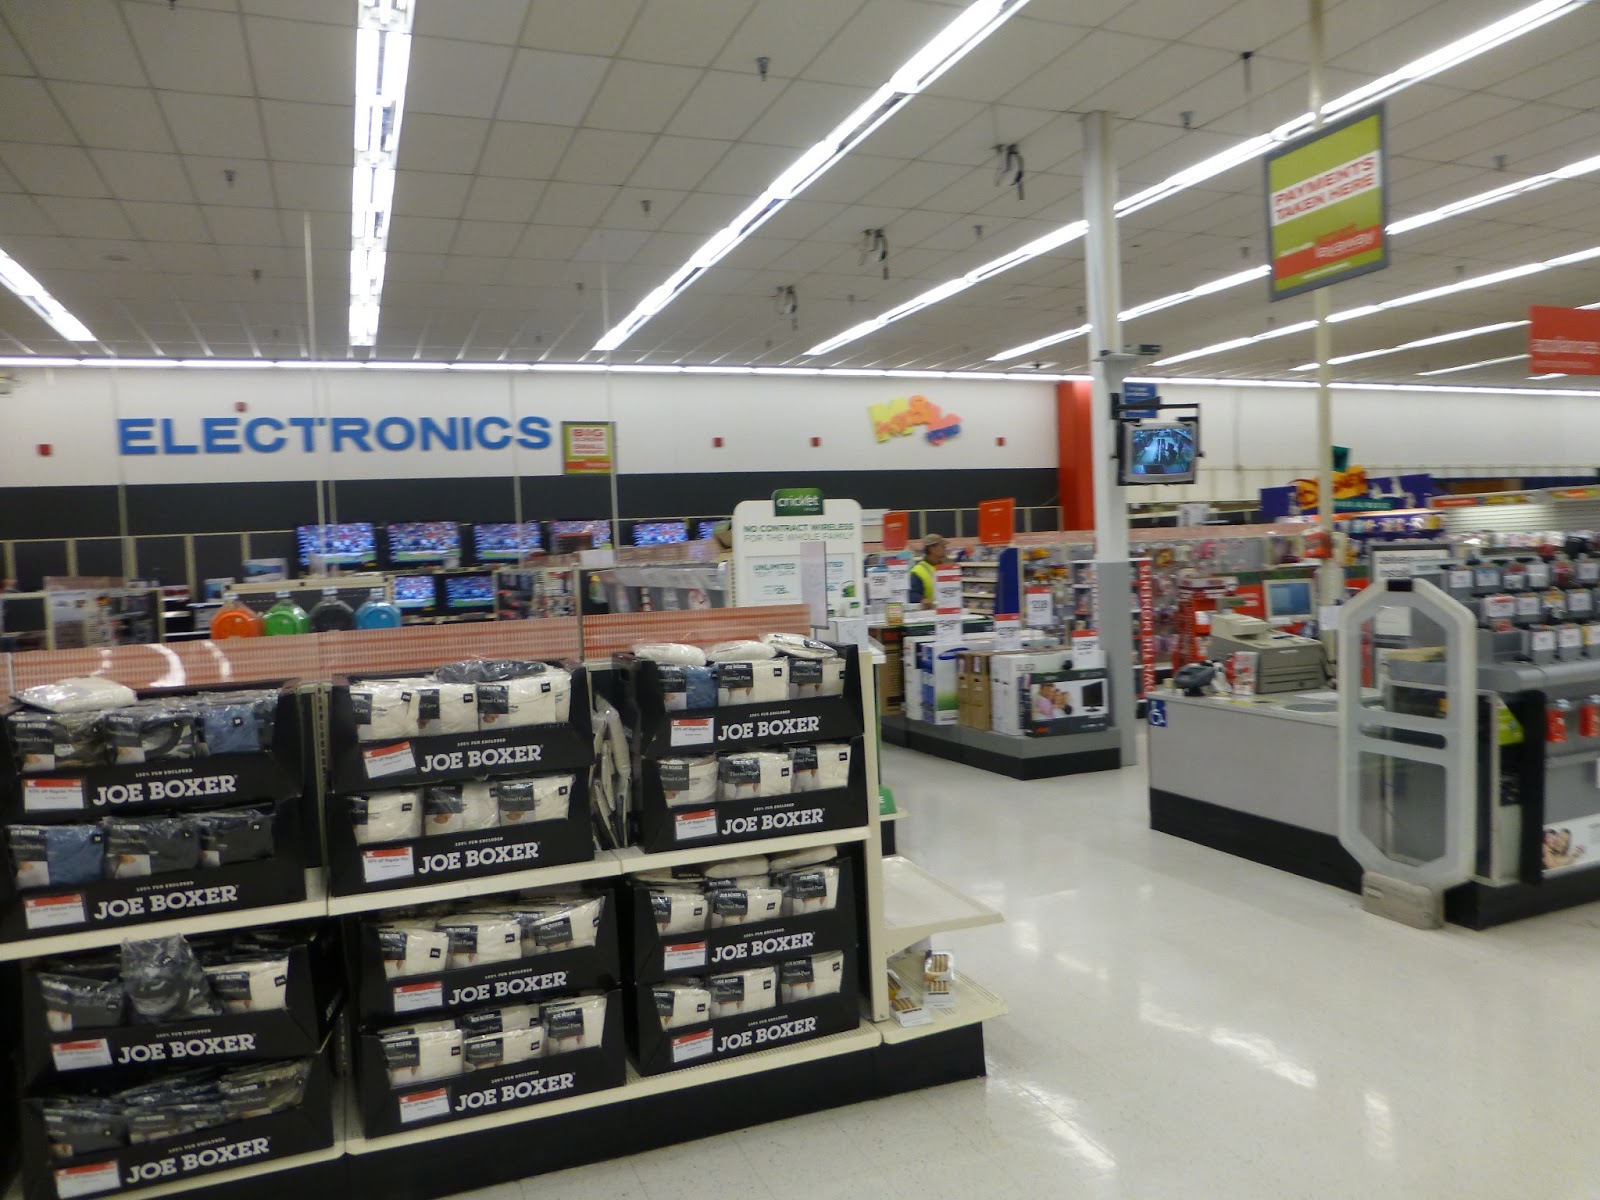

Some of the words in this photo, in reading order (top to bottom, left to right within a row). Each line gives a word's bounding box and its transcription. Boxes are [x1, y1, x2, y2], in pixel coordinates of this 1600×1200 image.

[1275, 156, 1374, 203] PAYMENTS
[118, 416, 551, 455] ELECTRONICS
[776, 495, 819, 507] cricket
[760, 524, 808, 532] CONTRACT
[718, 723, 753, 741] JOE
[757, 716, 819, 737] BOXER
[421, 752, 463, 772] JOE
[468, 744, 541, 767] BOXER
[93, 783, 143, 805] JOE
[148, 775, 236, 800] BOXER
[722, 816, 758, 835] JOE
[761, 808, 823, 830] BOXER
[419, 852, 461, 874] JOE
[465, 842, 539, 867] BOXER
[94, 897, 145, 920] JOE
[150, 885, 238, 912] BOXER
[711, 943, 747, 963] JOE
[751, 932, 813, 956] BOXER
[449, 983, 490, 1005] JOE
[495, 971, 567, 997] BOXER
[118, 1045, 166, 1064] JOE
[169, 1033, 256, 1058] BOXER
[717, 1031, 752, 1052] JOE
[756, 1017, 816, 1043] BOXER
[455, 1089, 497, 1111] JOE
[501, 1072, 574, 1101] BOXER
[126, 1158, 177, 1183] JOE
[182, 1137, 270, 1171] BOXER
